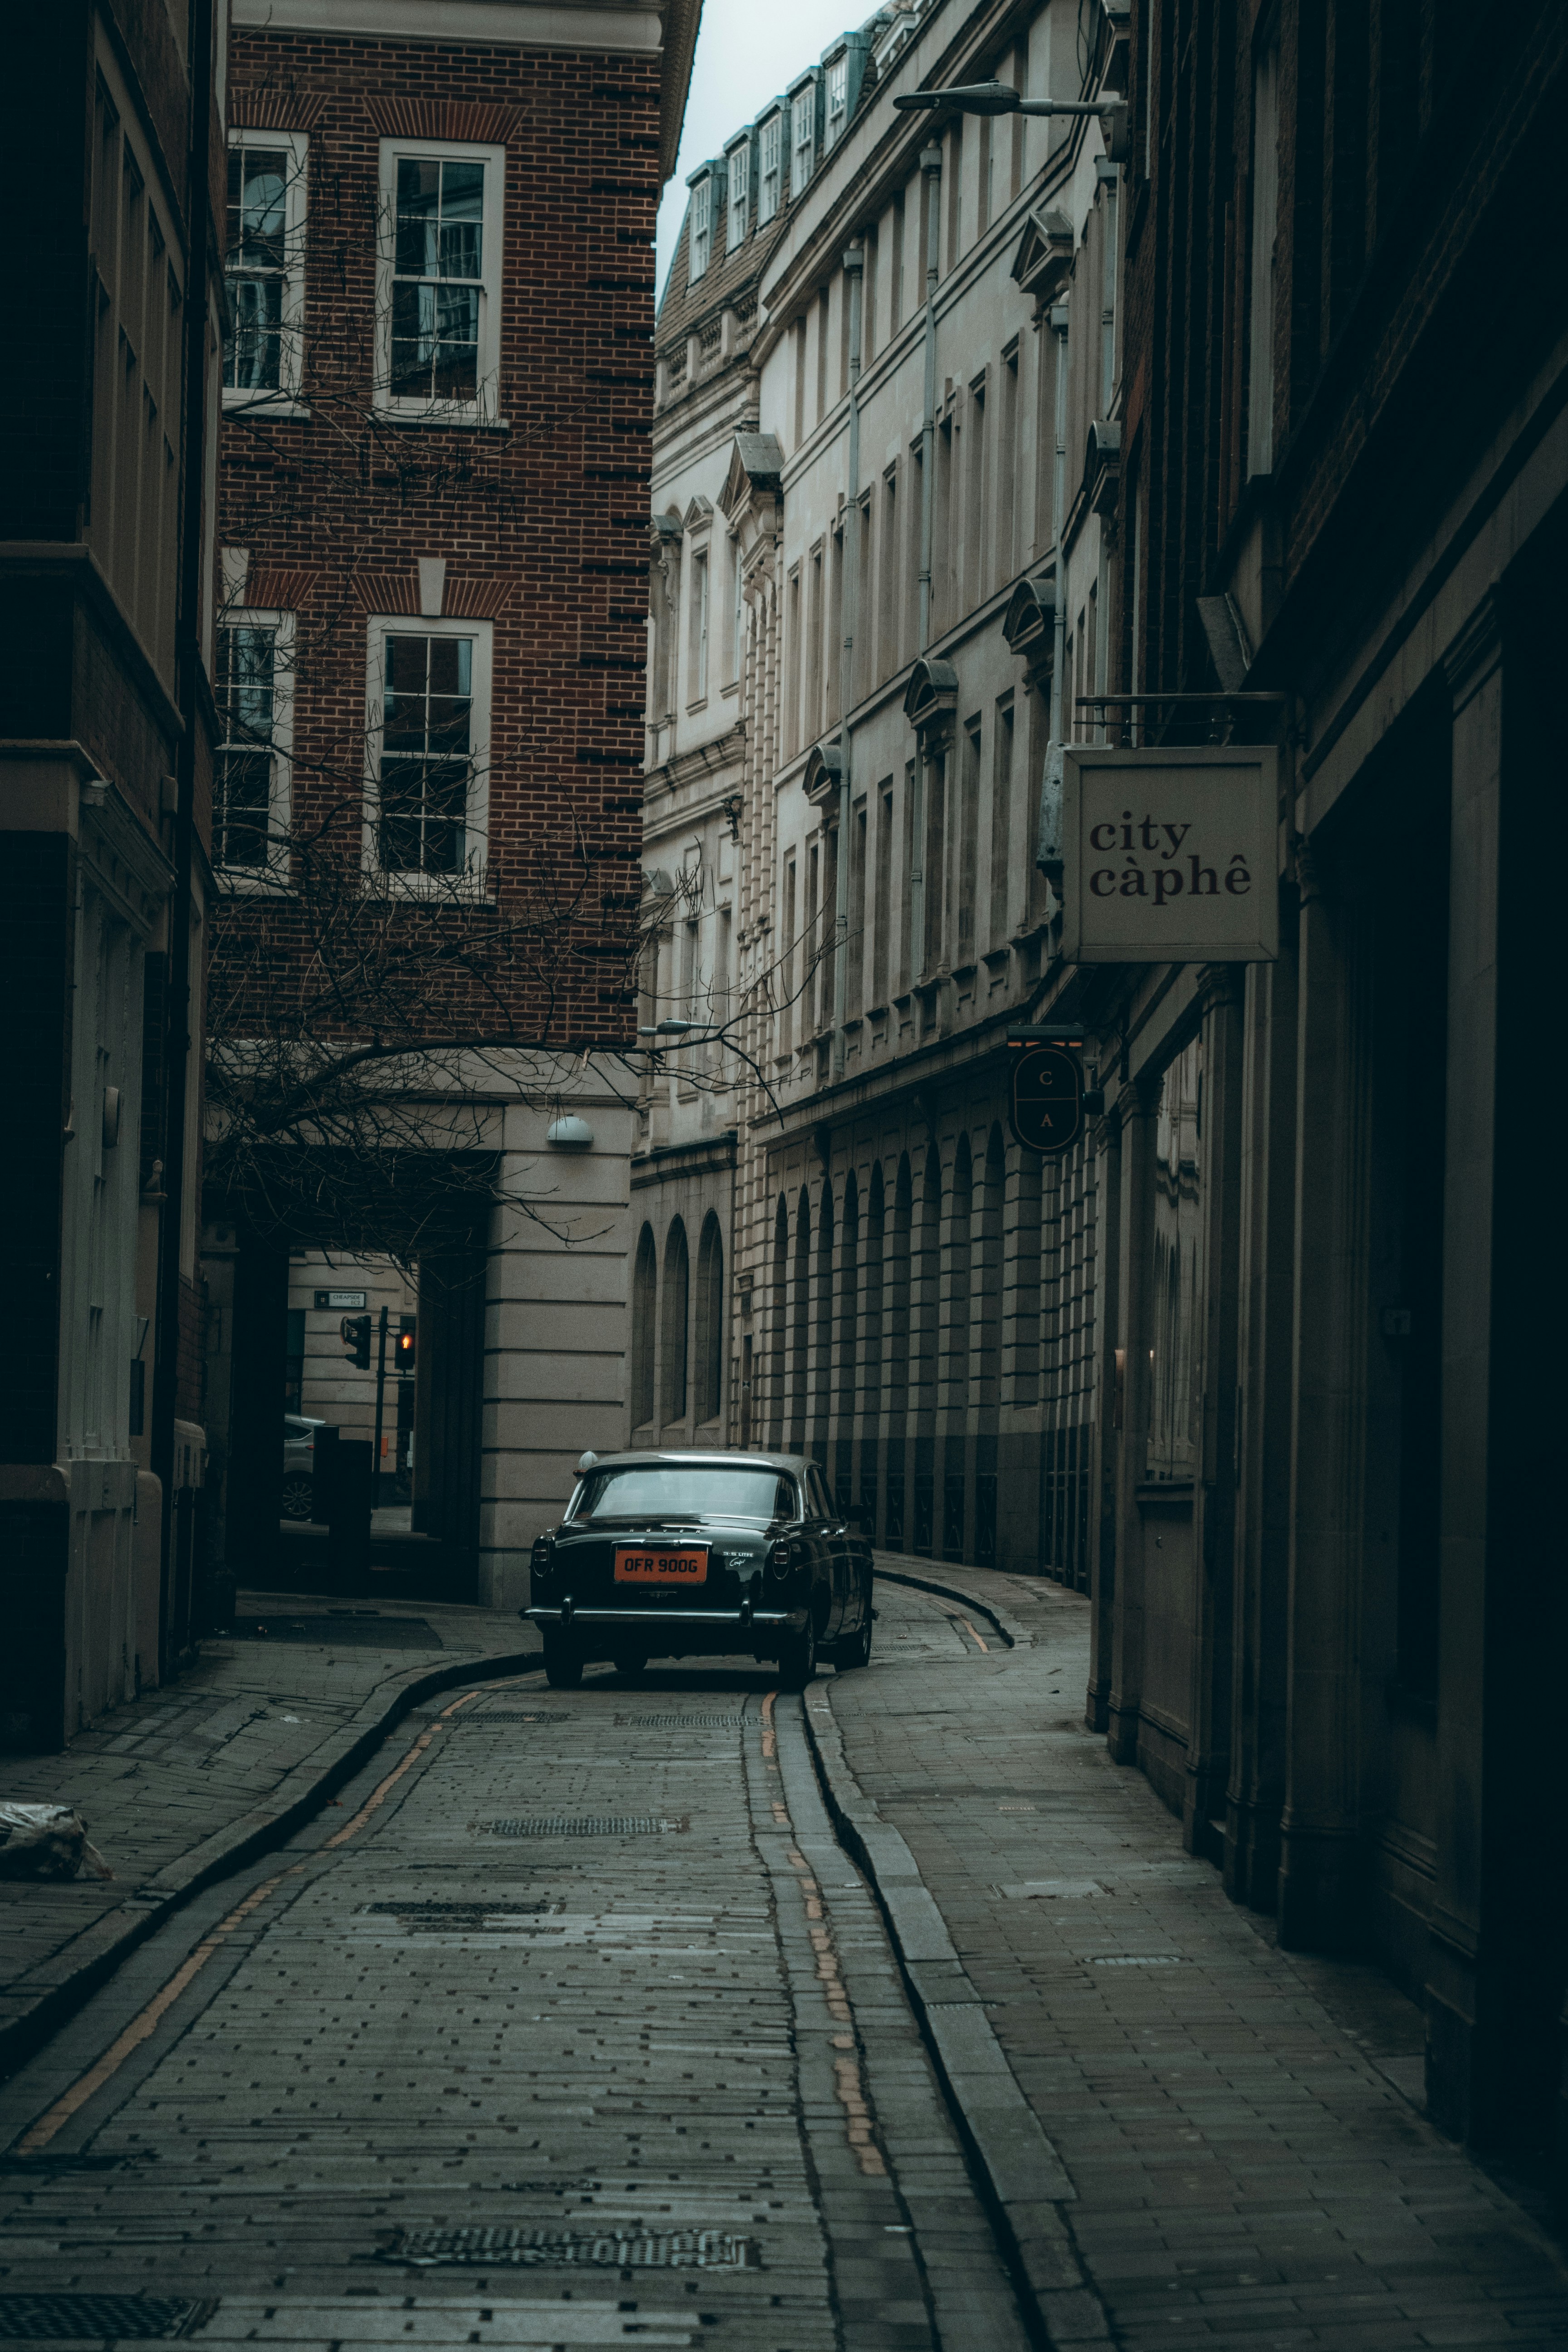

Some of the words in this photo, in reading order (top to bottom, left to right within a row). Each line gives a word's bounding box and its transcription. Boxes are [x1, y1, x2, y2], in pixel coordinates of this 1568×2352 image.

[1089, 810, 1191, 859] city
[1089, 854, 1251, 906] càphê
[1039, 1071, 1053, 1086] C
[1039, 1113, 1054, 1127] A
[624, 1558, 653, 1572] OFR
[658, 1558, 697, 1573] 900G
